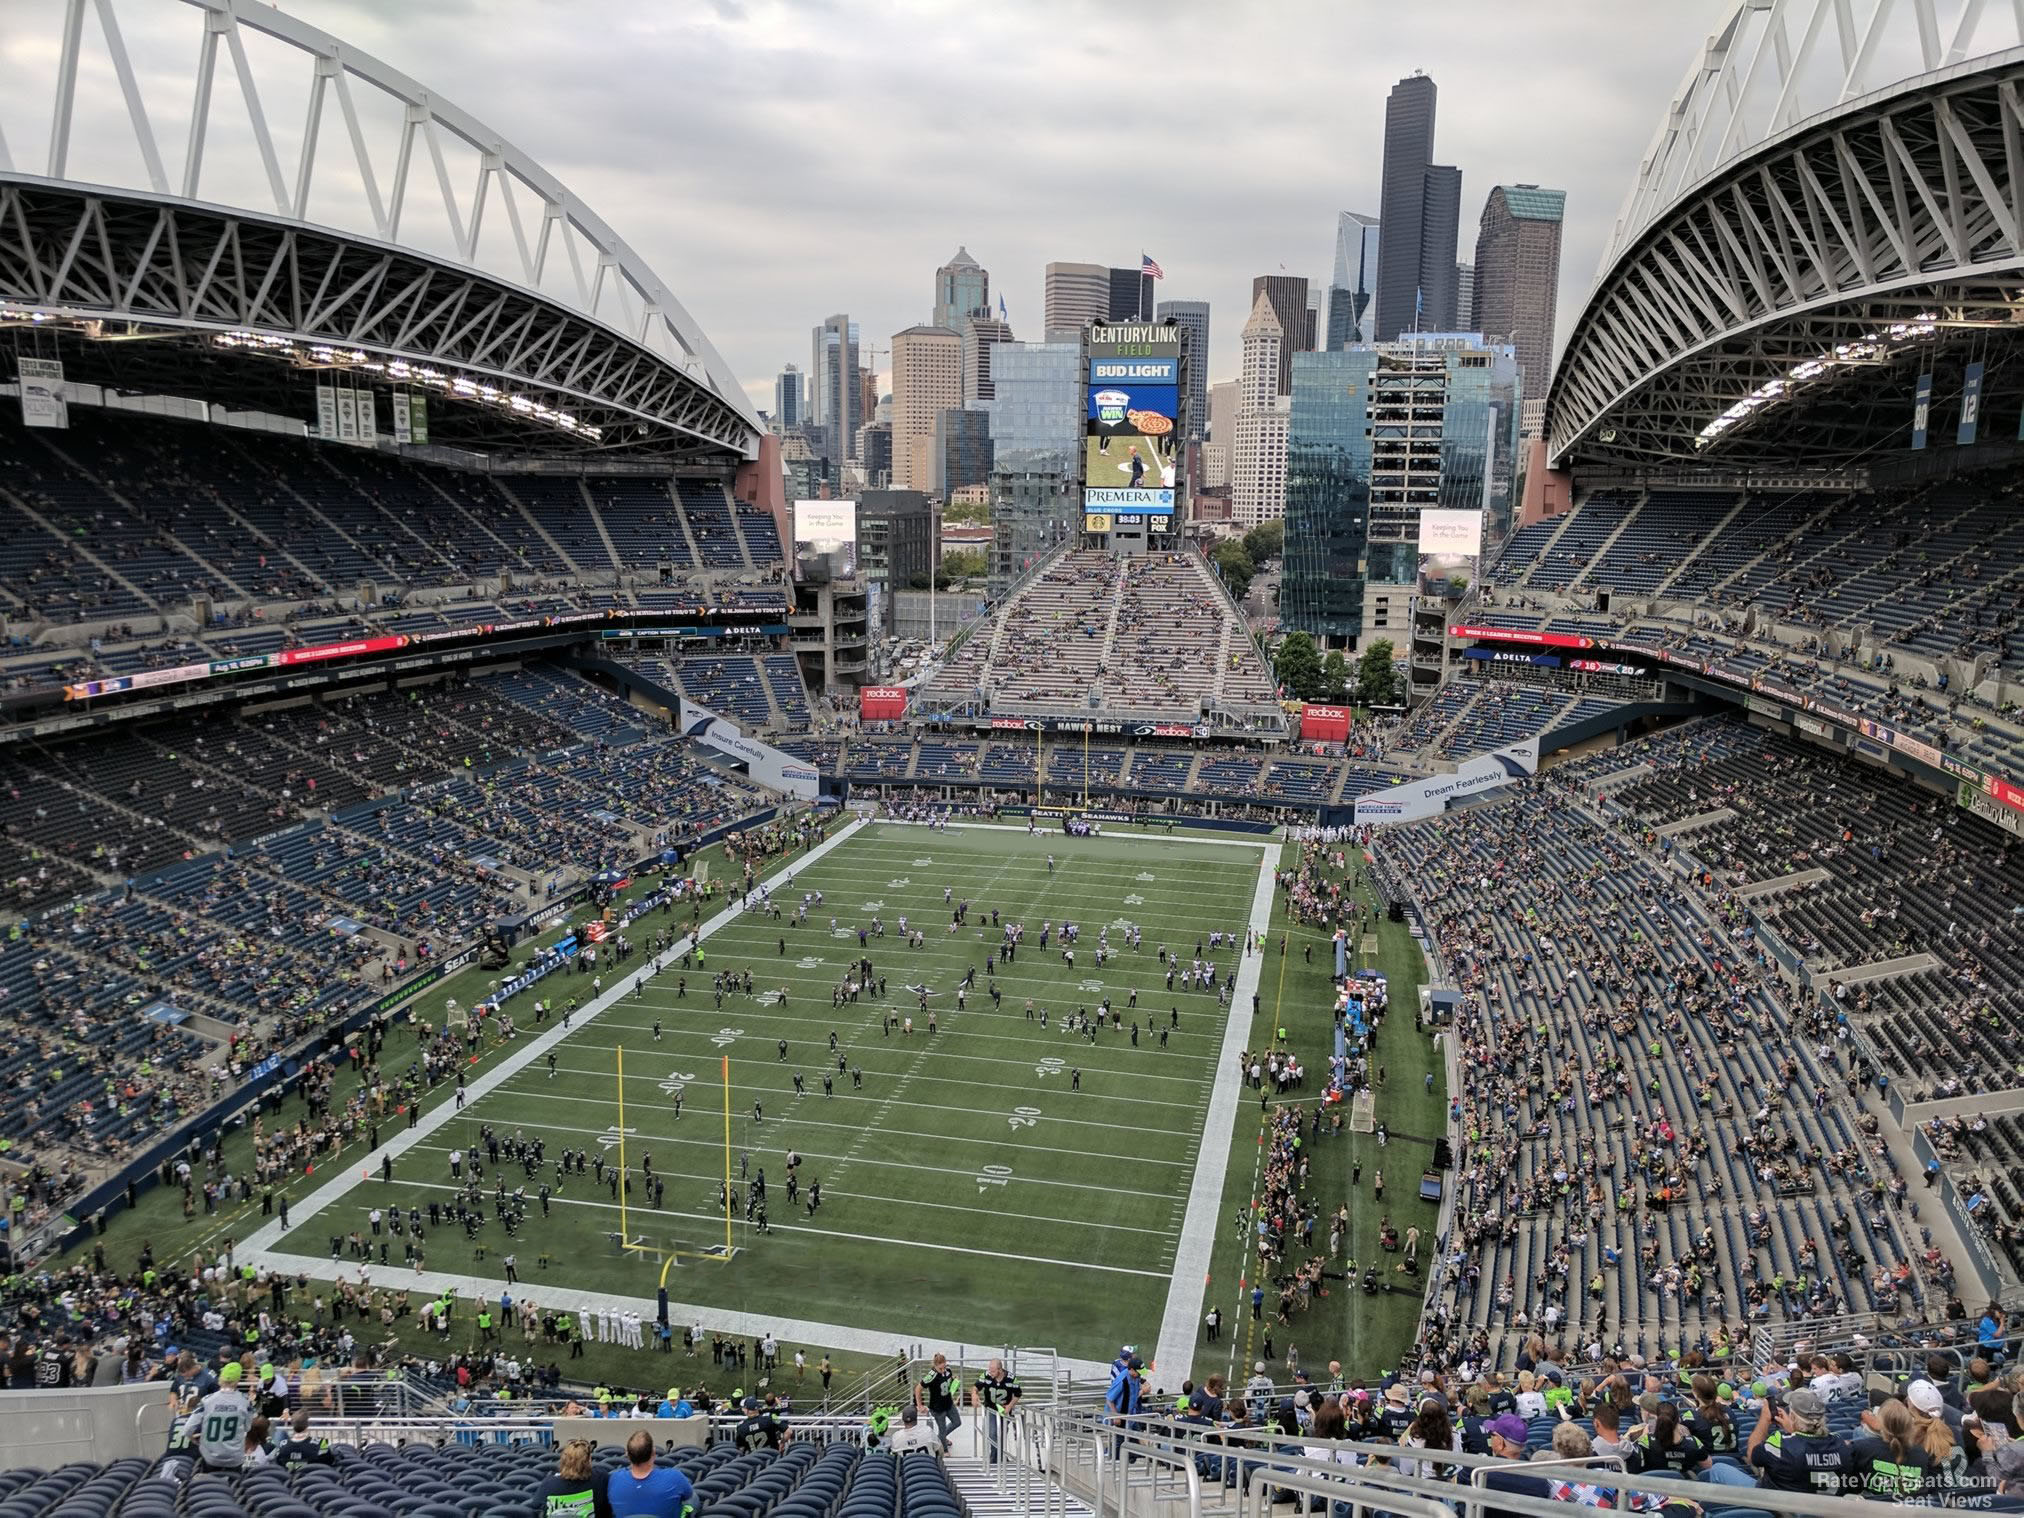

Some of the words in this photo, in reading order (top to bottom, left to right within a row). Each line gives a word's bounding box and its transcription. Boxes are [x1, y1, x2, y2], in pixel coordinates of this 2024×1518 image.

[1117, 345, 1152, 355] FIELD
[1096, 365, 1127, 377] BUD
[1128, 365, 1171, 377] LIGHT
[1962, 394, 1977, 424] 12
[1087, 490, 1151, 503] PREMERA
[1150, 515, 1169, 525] Q13
[1502, 653, 1531, 662] DELTA
[1584, 662, 1596, 670] 16
[1621, 666, 1634, 675] 20
[1057, 722, 1093, 732] HAWKS
[1096, 724, 1122, 733] NEST
[711, 730, 733, 746] Insure
[734, 741, 766, 761] Carefully
[1424, 783, 1455, 799] Dream
[1456, 770, 1503, 790] Fearlessly
[1080, 812, 1130, 822] SEAHAWKS
[1970, 794, 2018, 831] CenturyLink
[710, 1027, 745, 1043] 30
[1035, 1057, 1066, 1075] 30
[658, 1071, 696, 1090] 20
[1007, 1106, 1042, 1127] 20
[596, 1125, 638, 1144] 10
[976, 1165, 1013, 1186] 10
[989, 1387, 1008, 1404] 12
[206, 1416, 239, 1442] 09
[745, 1430, 769, 1451] 12
[1805, 1452, 1842, 1467] WILSON
